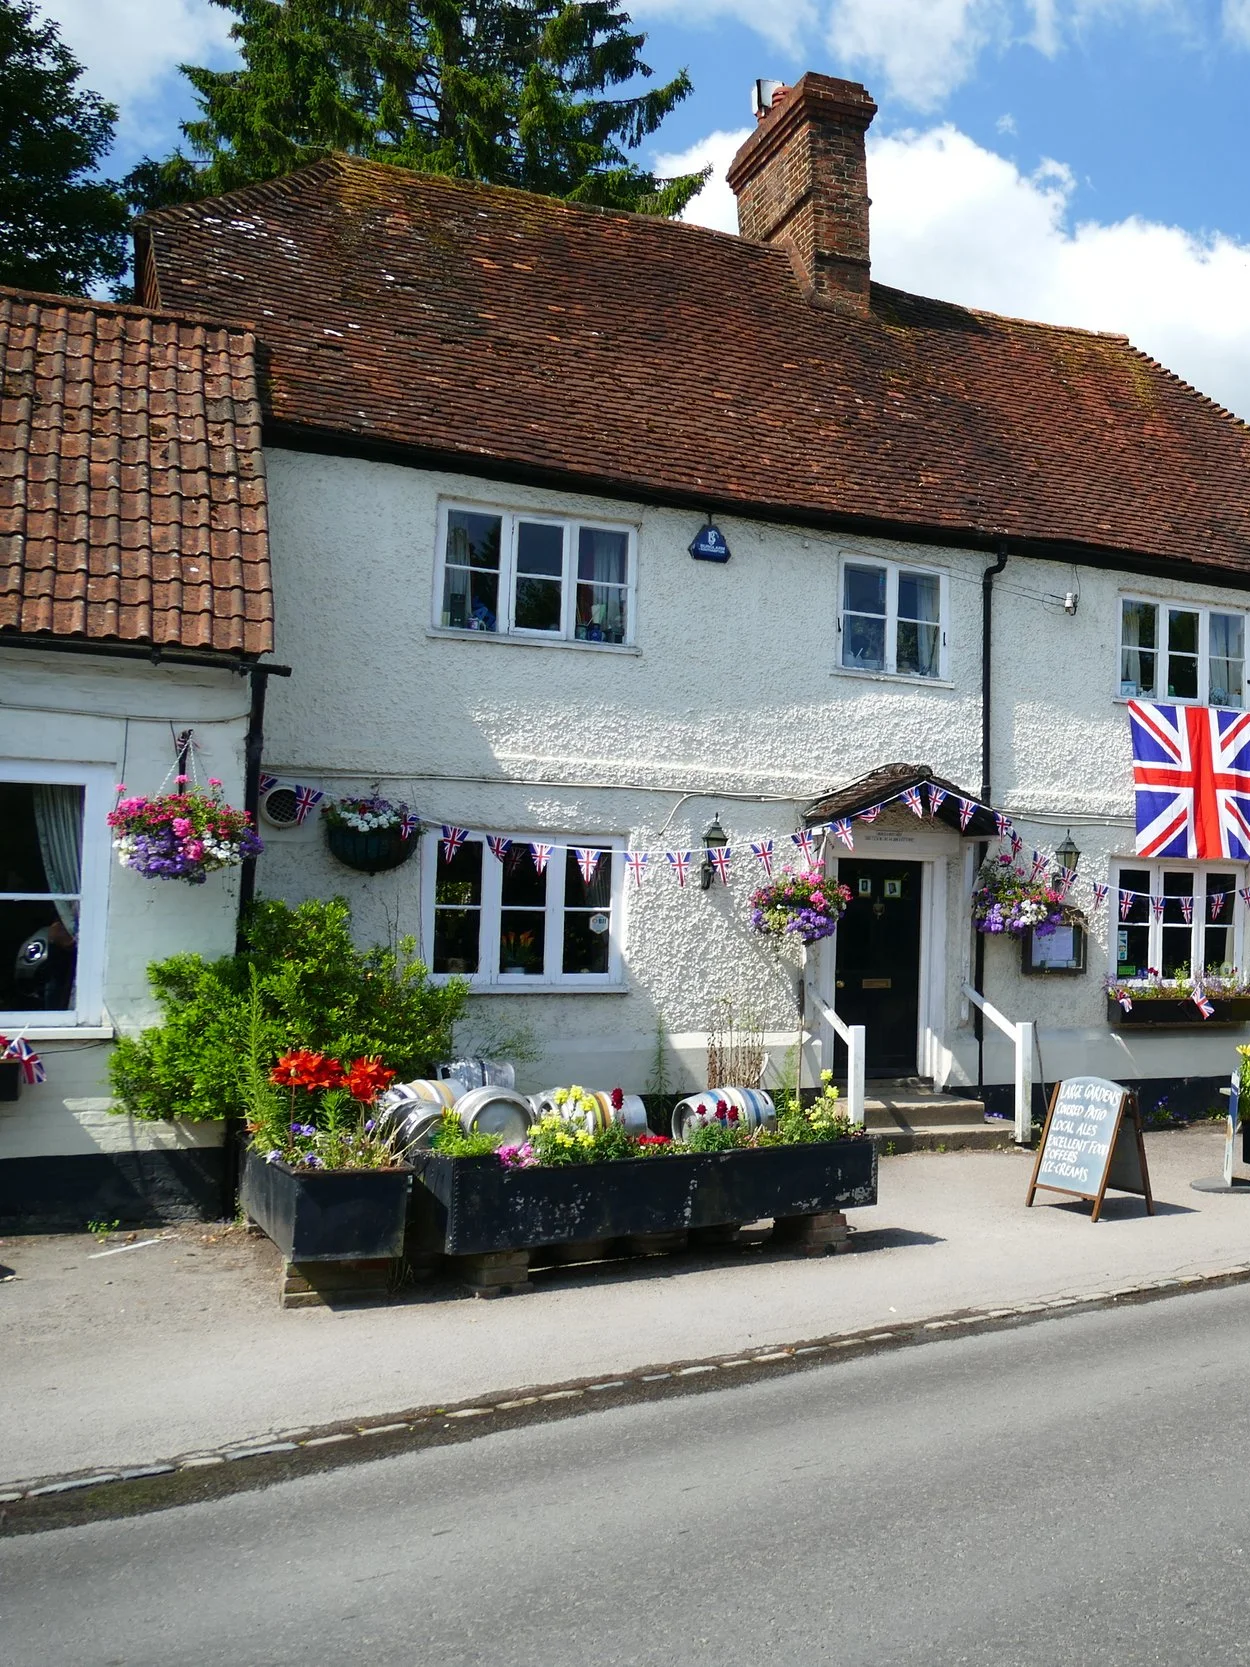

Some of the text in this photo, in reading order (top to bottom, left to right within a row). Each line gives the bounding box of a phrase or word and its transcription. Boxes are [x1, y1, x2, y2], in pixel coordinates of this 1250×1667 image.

[1060, 1084, 1121, 1106] LARGE GARDENS
[1056, 1102, 1108, 1120] COVERED PATIO
[1052, 1119, 1098, 1136] LOCAL ALES
[1047, 1134, 1089, 1152] EXCELLENT
[1044, 1148, 1078, 1162] COFFEES
[1042, 1161, 1088, 1182] ICE-CREAMS
